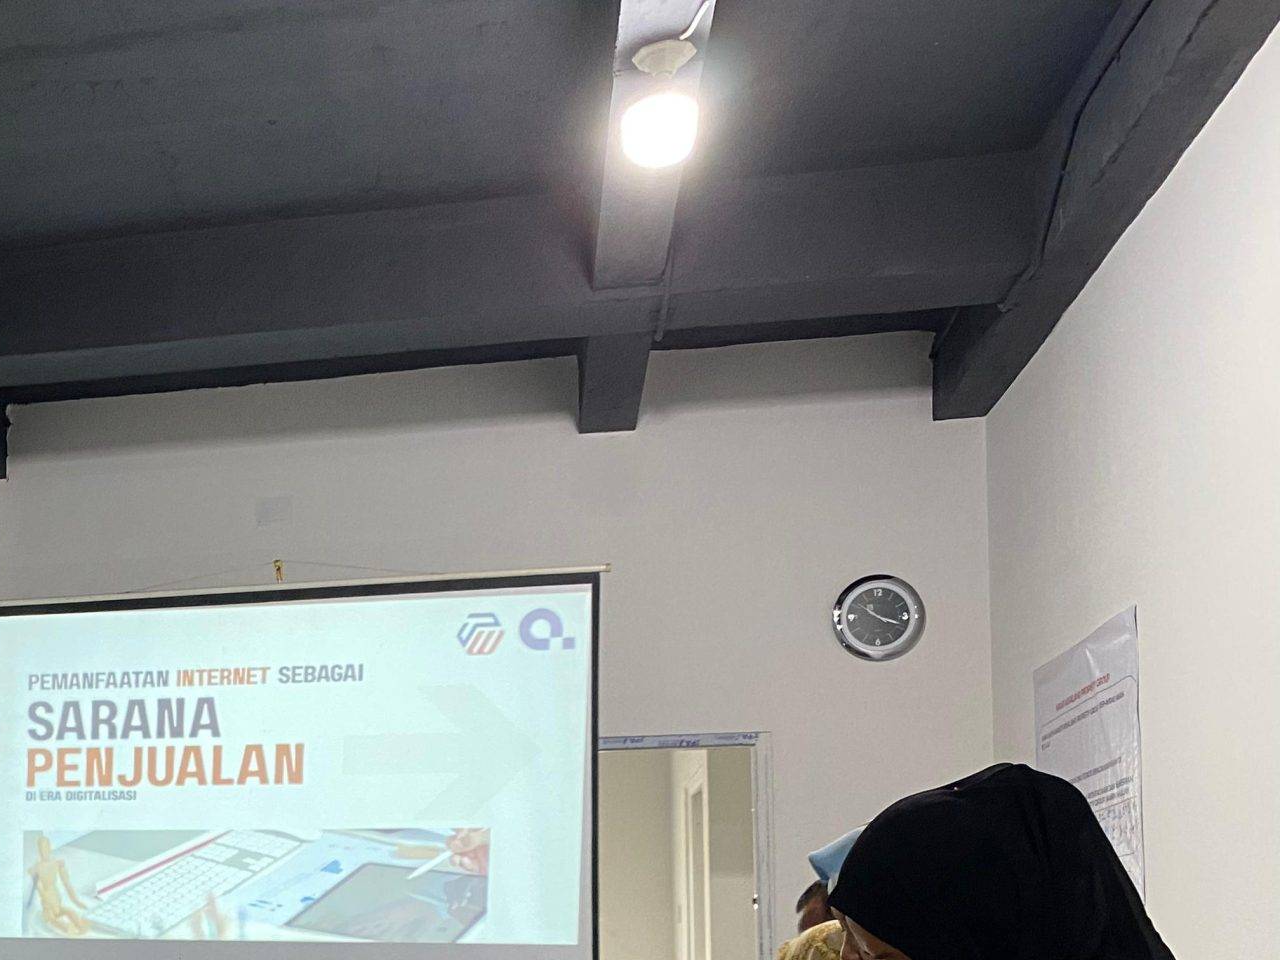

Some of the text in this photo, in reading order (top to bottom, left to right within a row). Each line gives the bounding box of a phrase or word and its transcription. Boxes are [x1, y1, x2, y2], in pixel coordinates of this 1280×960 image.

[873, 589, 883, 597] 12
[901, 612, 909, 620] 3
[28, 664, 364, 690] PEMANFAATAN INTERNET SEBAGAI
[27, 697, 221, 741] SARANA
[26, 743, 305, 787] PENJUALAN
[26, 790, 137, 801] DI ERA DIGITALISASI
